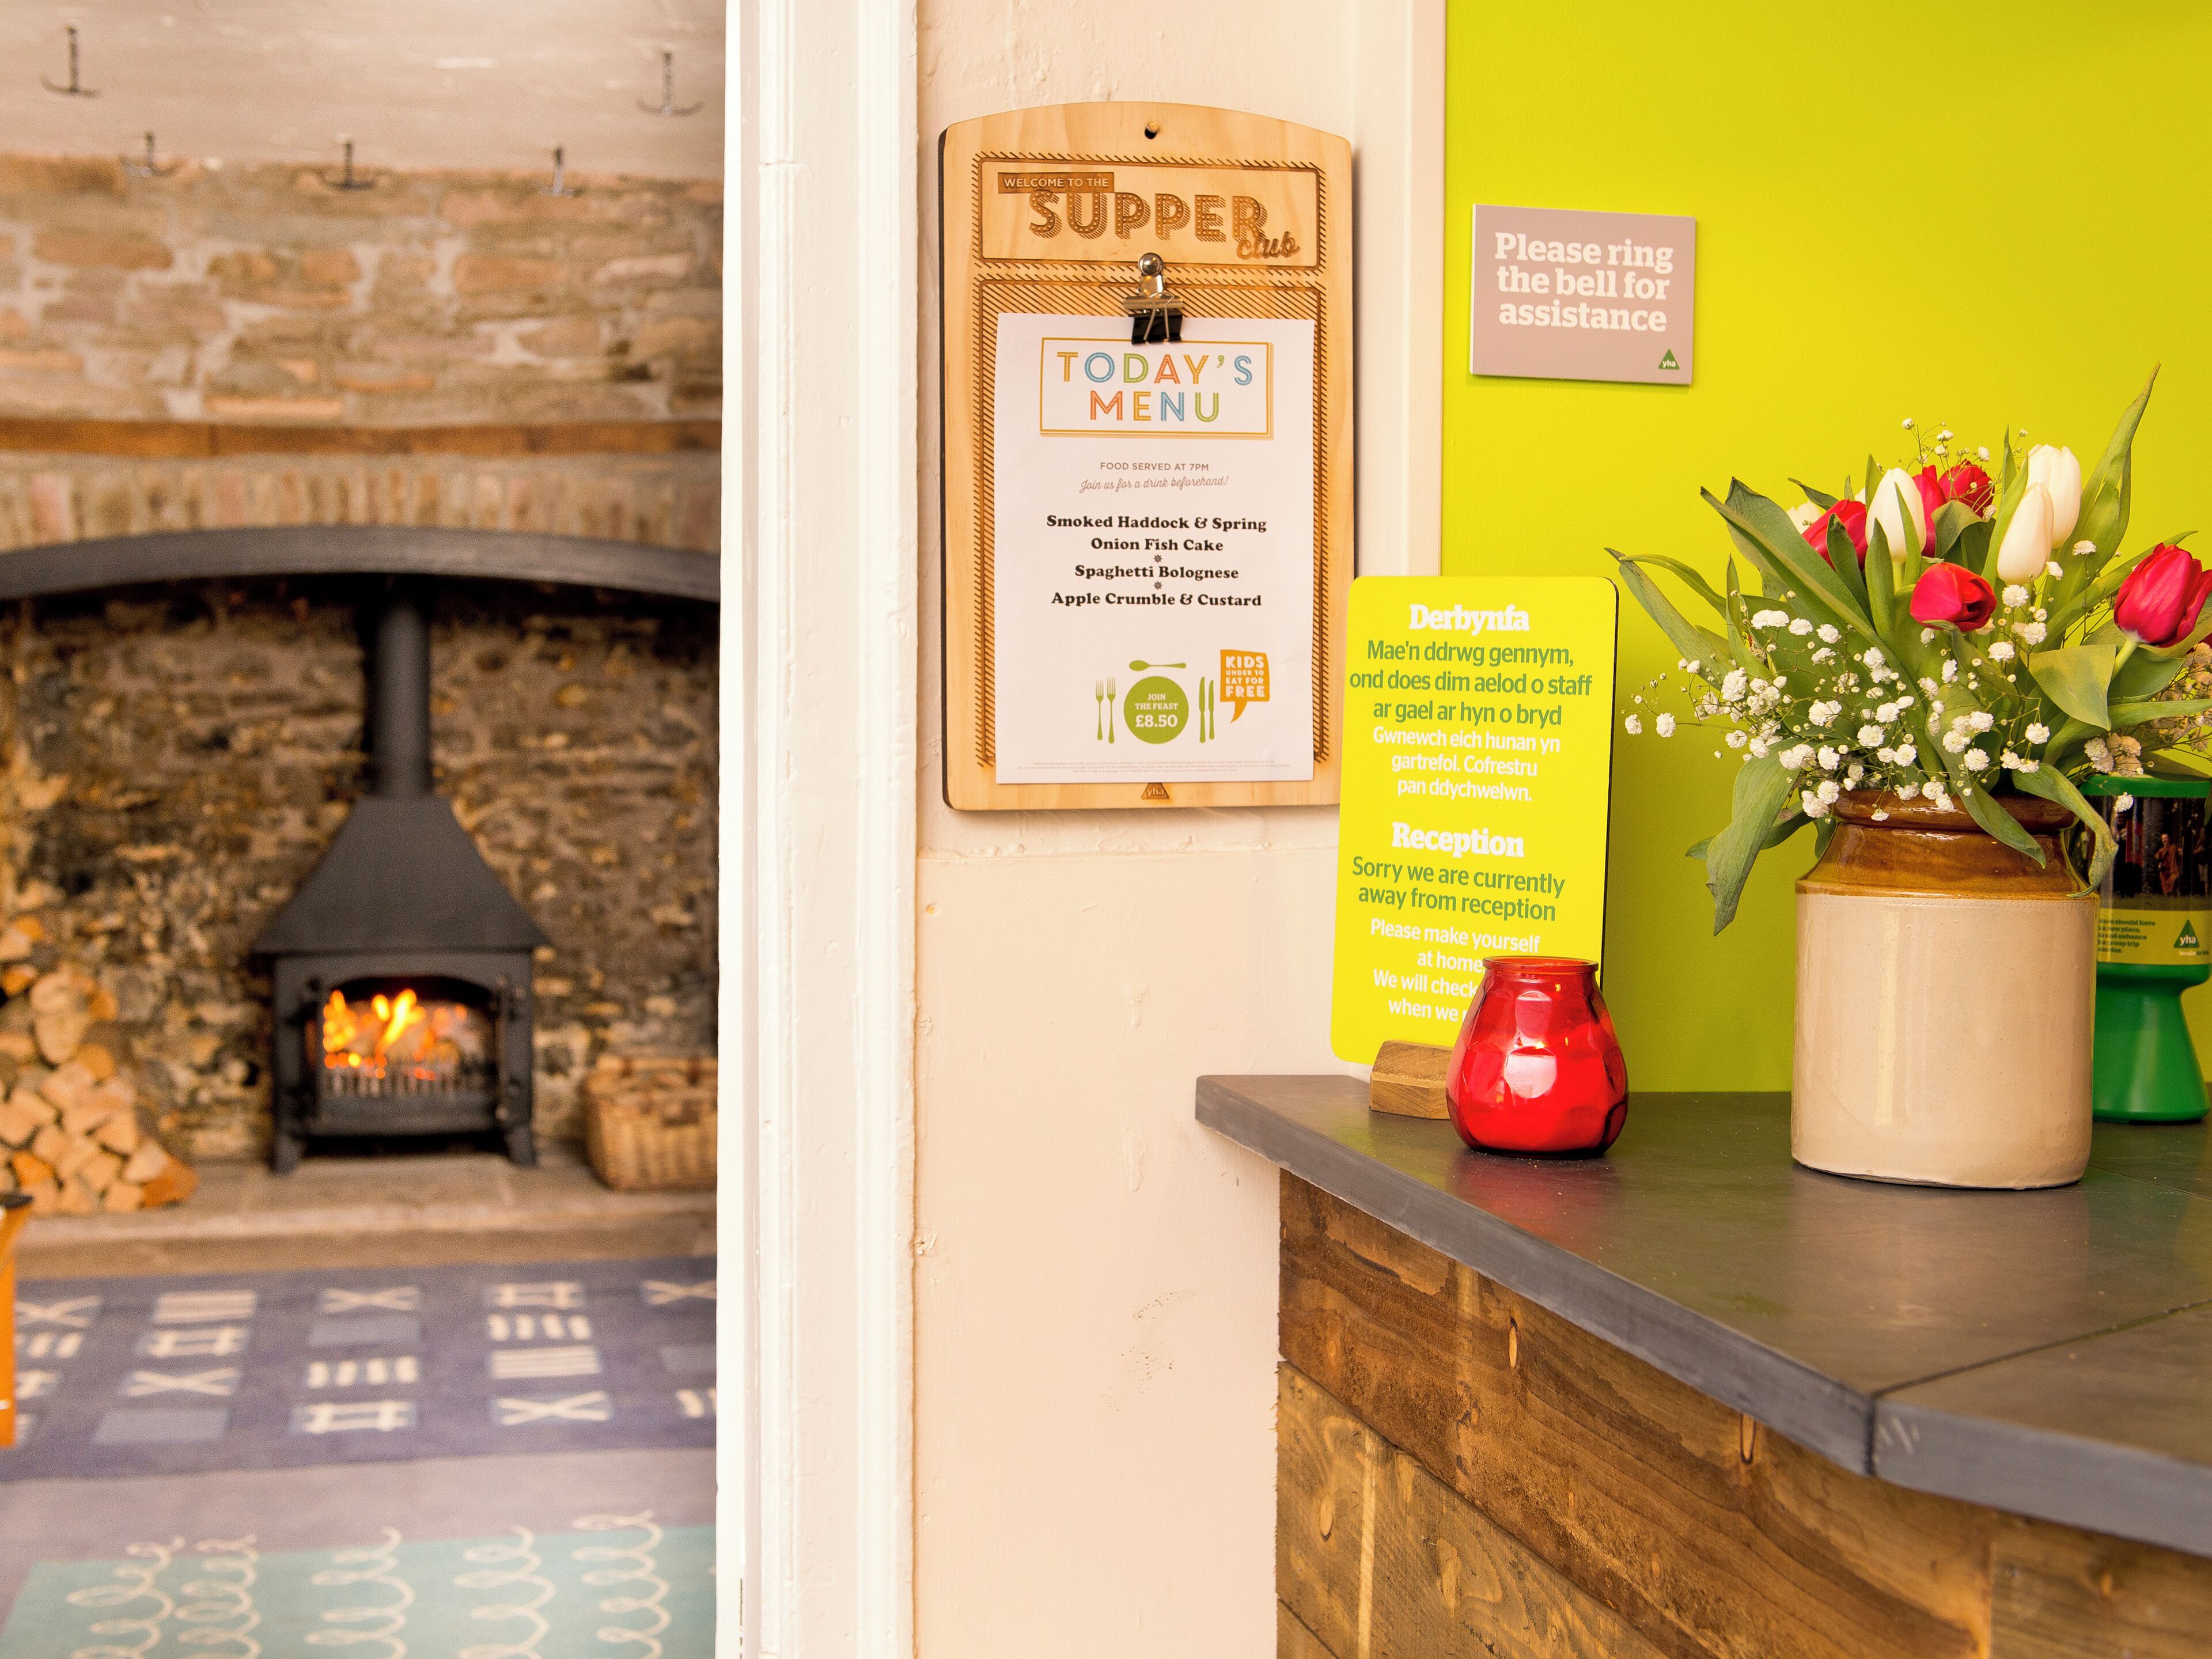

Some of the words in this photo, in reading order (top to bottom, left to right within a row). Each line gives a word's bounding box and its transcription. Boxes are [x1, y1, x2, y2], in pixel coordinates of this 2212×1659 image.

[1003, 177, 1064, 188] WELCOME
[1067, 178, 1083, 187] TO
[1086, 177, 1109, 188] THE
[1028, 190, 1268, 243] SUPPER
[1236, 231, 1301, 260] club
[1495, 232, 1601, 264] Please
[1607, 238, 1673, 274] ring
[1497, 266, 1550, 294] the
[1555, 268, 1618, 298] bell
[1624, 272, 1670, 300] for
[1499, 300, 1666, 332] assistance
[1057, 352, 1253, 386] TODAY'S
[1662, 359, 1676, 368] yha
[1090, 391, 1219, 422] MENU
[1100, 462, 1128, 471] FOOD
[1132, 463, 1171, 471] SERVED
[1174, 463, 1186, 471] AT
[1190, 463, 1209, 471] 7PM
[1079, 479, 1101, 493] Join
[1104, 480, 1113, 490] us
[1115, 478, 1131, 493] for
[1134, 480, 1141, 488] a
[1143, 476, 1168, 488] drink
[1171, 476, 1229, 490] beforehand!
[1047, 515, 1113, 528] Smoked
[1118, 516, 1190, 529] Haddock
[1195, 517, 1207, 529] &
[1212, 517, 1267, 533] Spring
[1091, 537, 1140, 550] Onion
[1145, 539, 1178, 551] Fish
[1184, 539, 1224, 551] Cake
[1075, 565, 1154, 581] Spaghetti
[1158, 566, 1238, 582] Bolognese
[1051, 592, 1101, 606] Apple
[1105, 593, 1176, 605] Crumble
[1180, 594, 1193, 605] &
[1198, 594, 1262, 606] Custard
[1409, 604, 1529, 635] Derbynfa
[1226, 656, 1264, 668] KIDS
[1368, 640, 1419, 661] Mae'n
[1425, 642, 1484, 665] ddrwg
[1489, 647, 1574, 666] gennym,
[1226, 685, 1265, 697] FREE
[1350, 670, 1382, 688] ond
[1388, 671, 1430, 690] does
[1435, 671, 1469, 691] dim
[1475, 673, 1526, 693] aelod
[1531, 680, 1544, 693] o
[1548, 675, 1592, 695] staff
[1135, 714, 1178, 728] £8.50
[1373, 702, 1391, 718] ar
[1395, 700, 1433, 723] gael
[1438, 703, 1456, 719] ar
[1460, 703, 1494, 726] hyn
[1500, 708, 1512, 724] o
[1517, 704, 1561, 728] bryd
[1373, 726, 1446, 746] Gwnewch
[1450, 729, 1482, 748] eich
[1486, 732, 1536, 749] hunan
[1540, 736, 1560, 753] yn
[1392, 754, 1460, 772] gartrefol.
[1463, 755, 1537, 776] Cofrestru
[1147, 788, 1164, 797] yha
[1398, 780, 1425, 796] pan
[1429, 778, 1532, 801] ddychwelwn.
[1392, 822, 1524, 858] Reception
[1353, 856, 1402, 882] Sorry
[1407, 866, 1434, 881] we
[1438, 869, 1469, 885] are
[1474, 870, 1565, 898] currently
[1358, 887, 1406, 910] away
[1411, 888, 1456, 911] from
[1461, 896, 1555, 921] reception
[1371, 918, 1420, 940] Please
[1425, 926, 1468, 945] make
[1472, 931, 1540, 953] yourself
[2180, 935, 2196, 946] yha
[1418, 952, 1432, 965] at
[1373, 969, 1397, 987] We
[1401, 975, 1427, 992] will
[1431, 977, 1477, 997] check
[1389, 998, 1431, 1017] when
[1435, 1007, 1459, 1021] we
